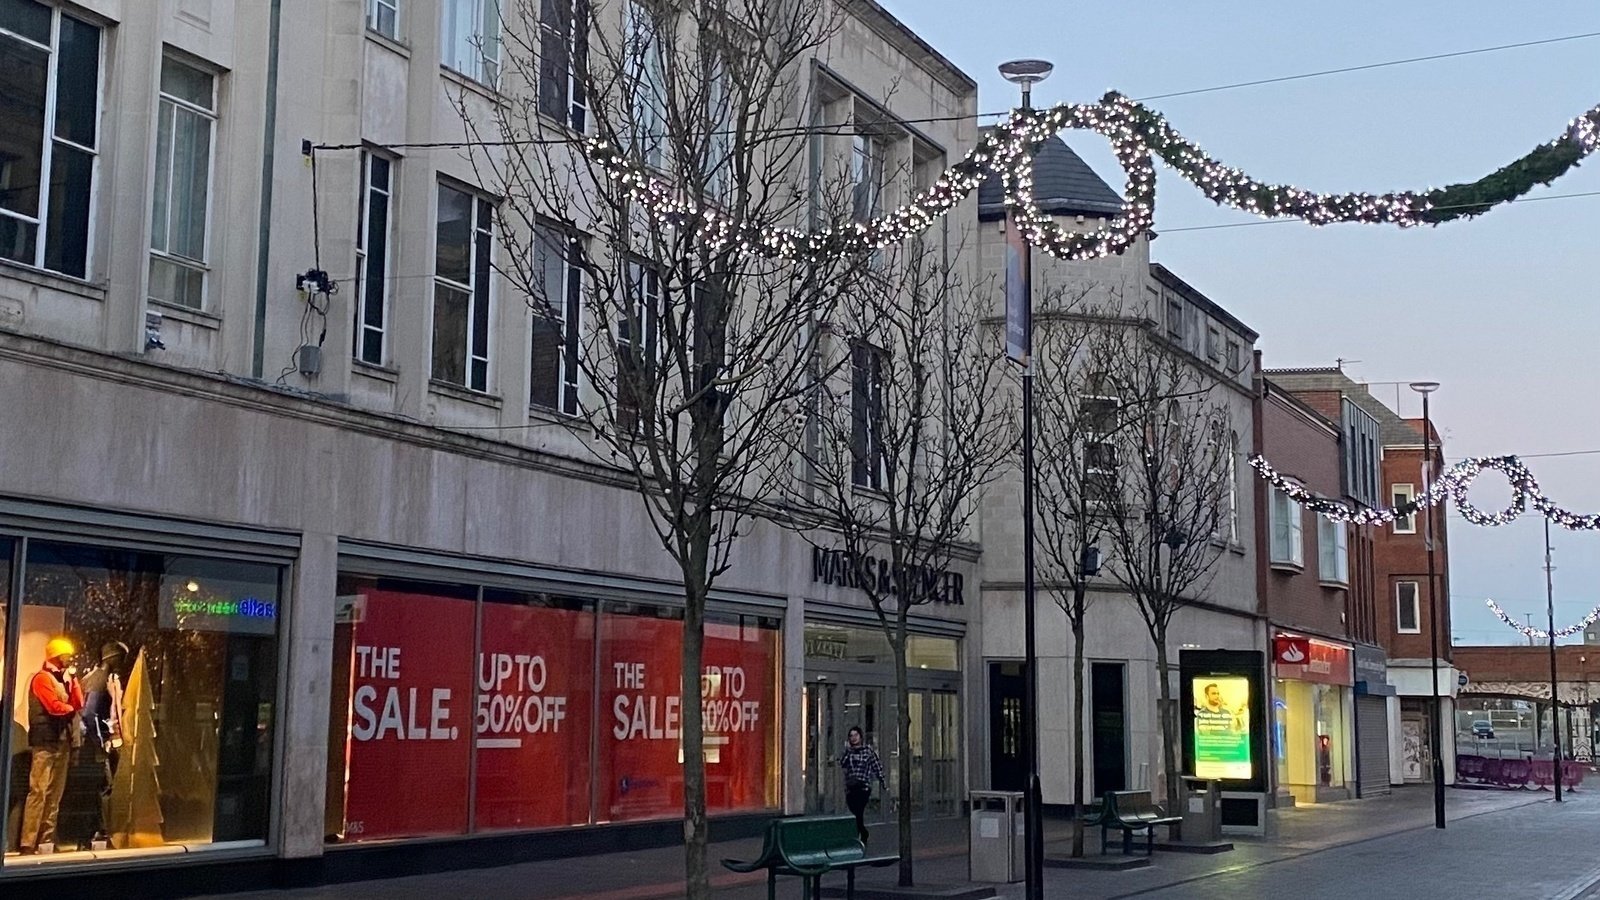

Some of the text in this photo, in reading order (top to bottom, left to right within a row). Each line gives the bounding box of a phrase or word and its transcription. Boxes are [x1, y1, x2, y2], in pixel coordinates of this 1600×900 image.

[892, 563, 964, 605] ENCER
[356, 646, 400, 678] THE
[478, 653, 546, 692] UP TO
[613, 662, 645, 689] THE
[353, 685, 458, 741] SALE.
